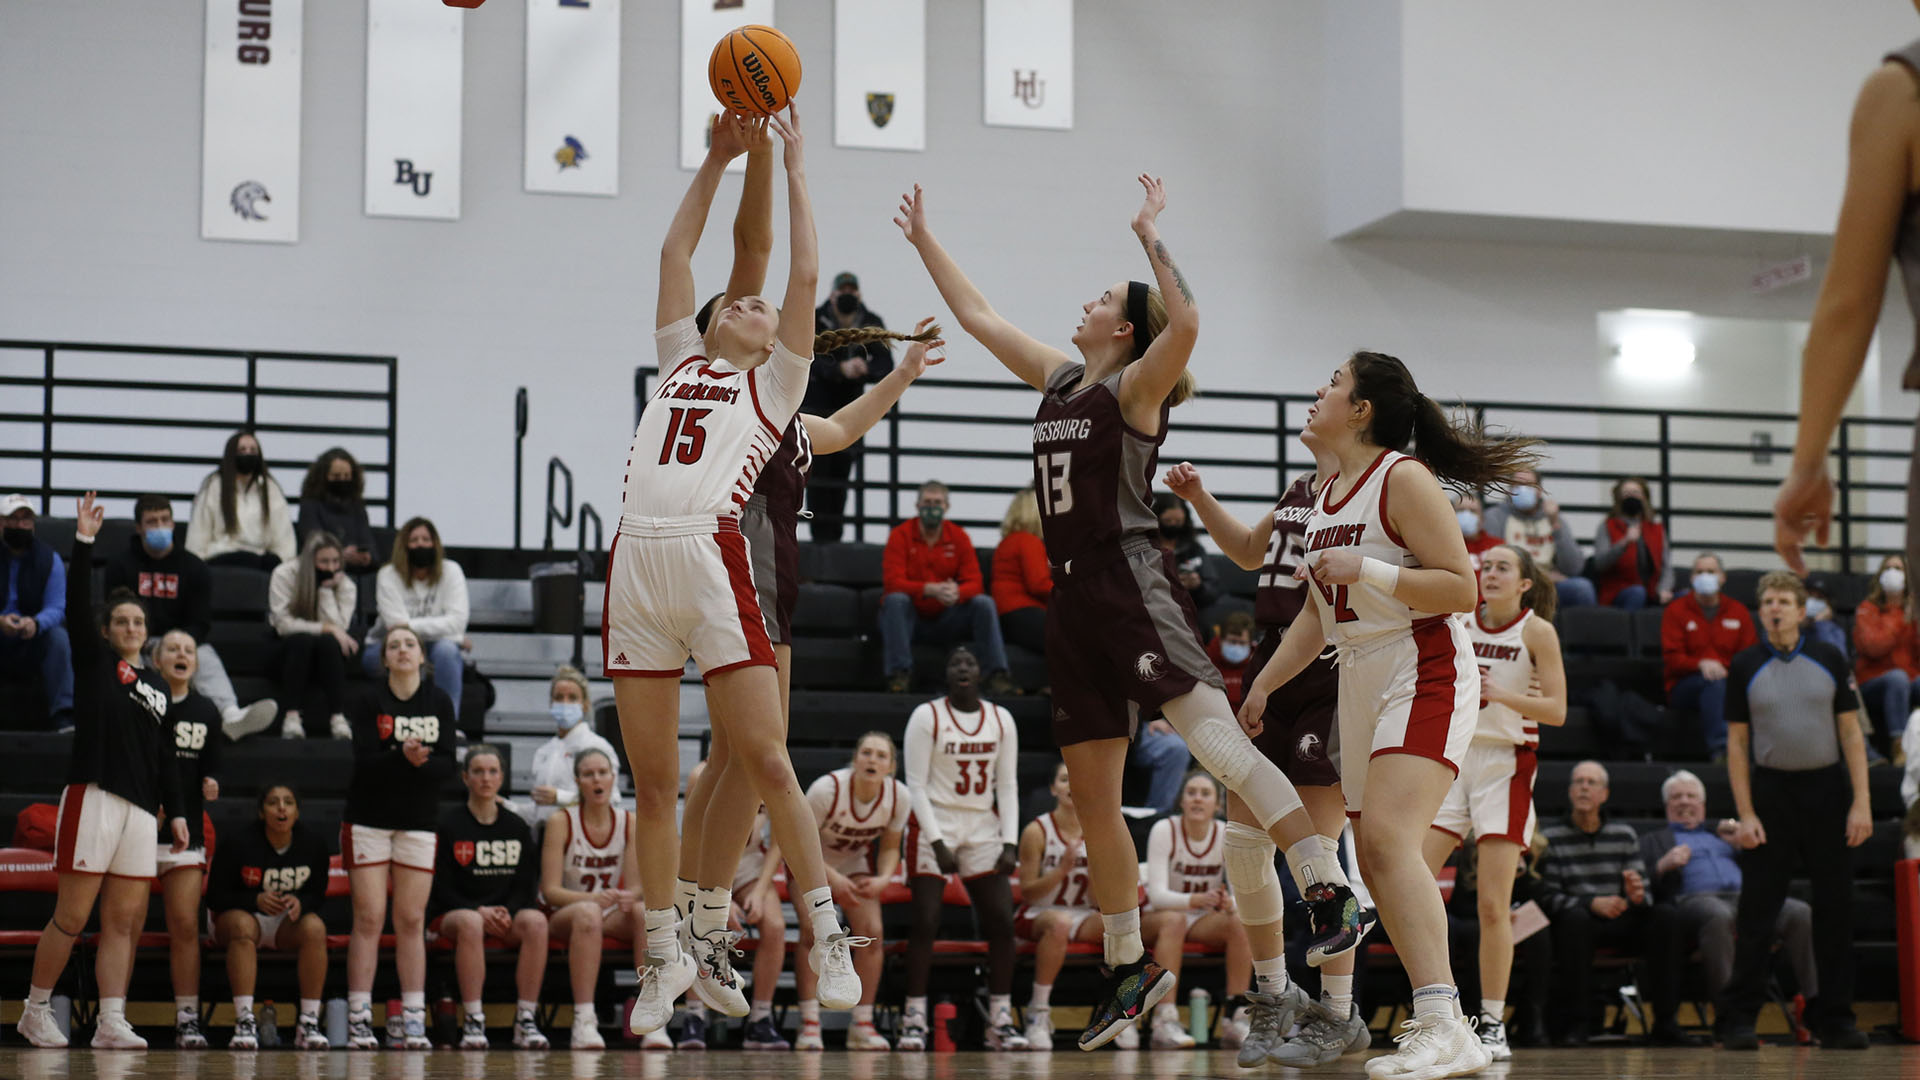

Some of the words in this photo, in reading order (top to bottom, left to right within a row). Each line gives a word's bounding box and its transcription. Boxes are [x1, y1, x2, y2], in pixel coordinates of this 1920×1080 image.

[742, 51, 777, 108] Wilson
[1014, 70, 1046, 109] HU
[394, 159, 432, 196] BU
[658, 407, 713, 465] 15
[1037, 451, 1073, 516] 13
[1258, 528, 1307, 589] 25
[394, 716, 440, 743] CSB
[955, 760, 989, 795] 33
[476, 840, 521, 866] CSB
